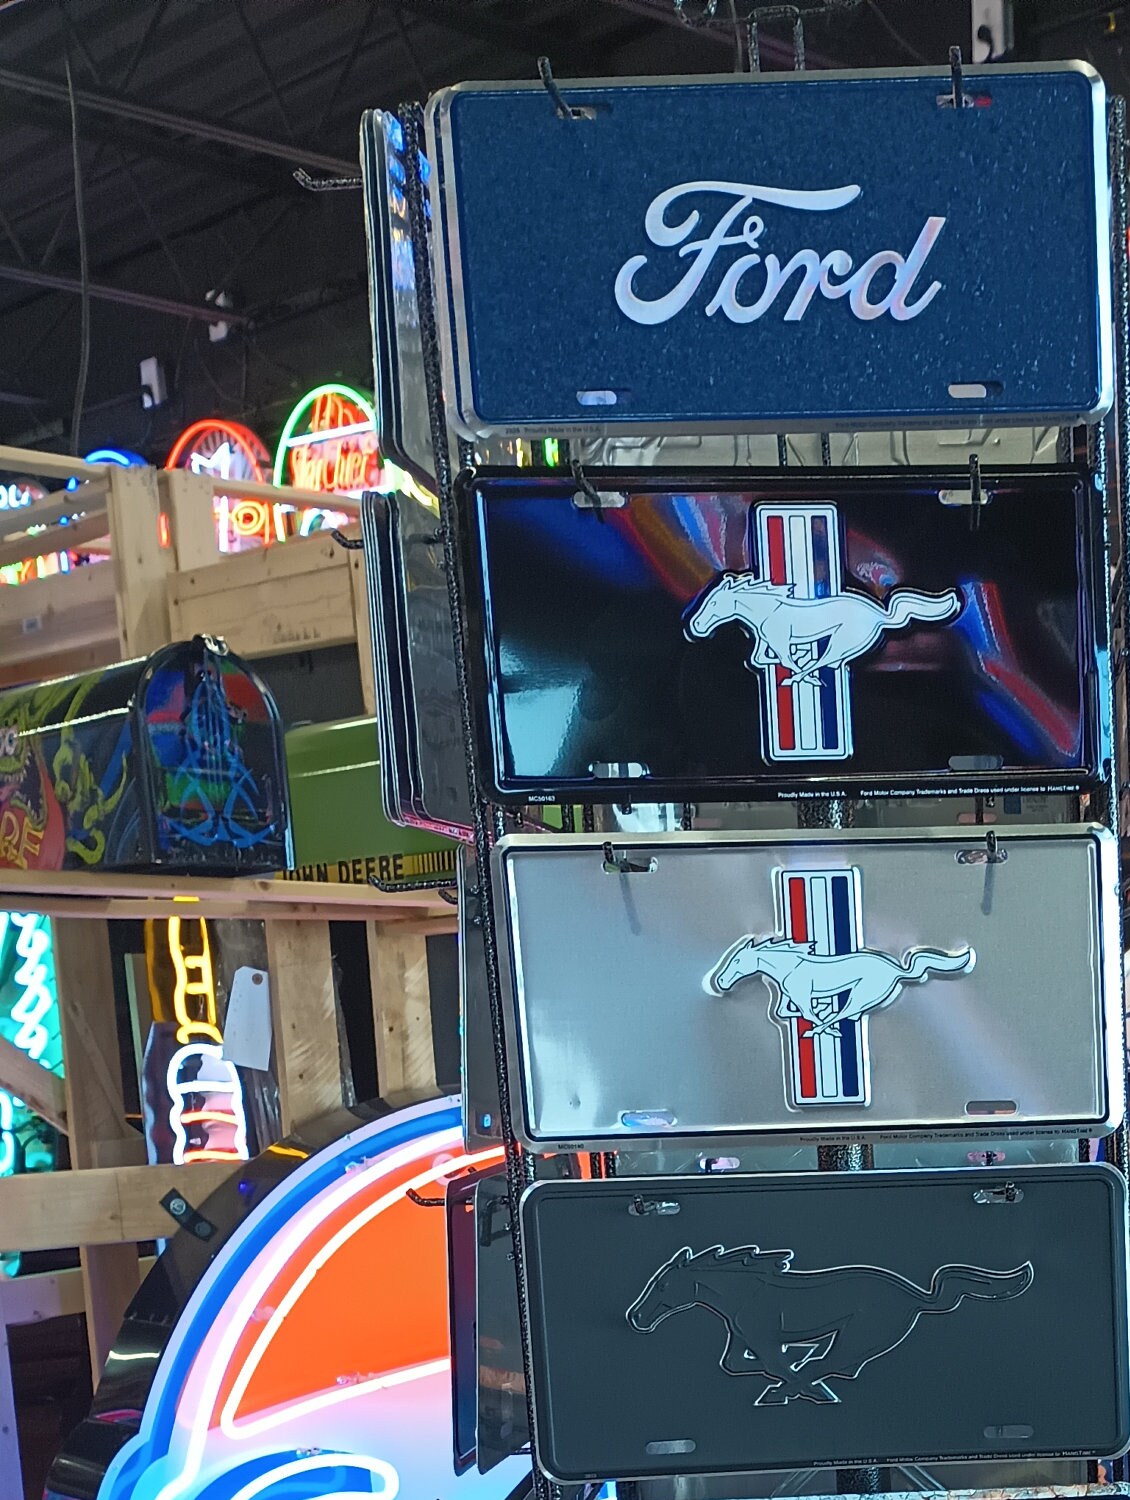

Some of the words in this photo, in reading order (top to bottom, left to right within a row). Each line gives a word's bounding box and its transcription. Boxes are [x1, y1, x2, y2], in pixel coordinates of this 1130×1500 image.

[614, 180, 946, 325] Ford
[916, 787, 946, 795] Trademarks
[338, 854, 404, 884] DEERE
